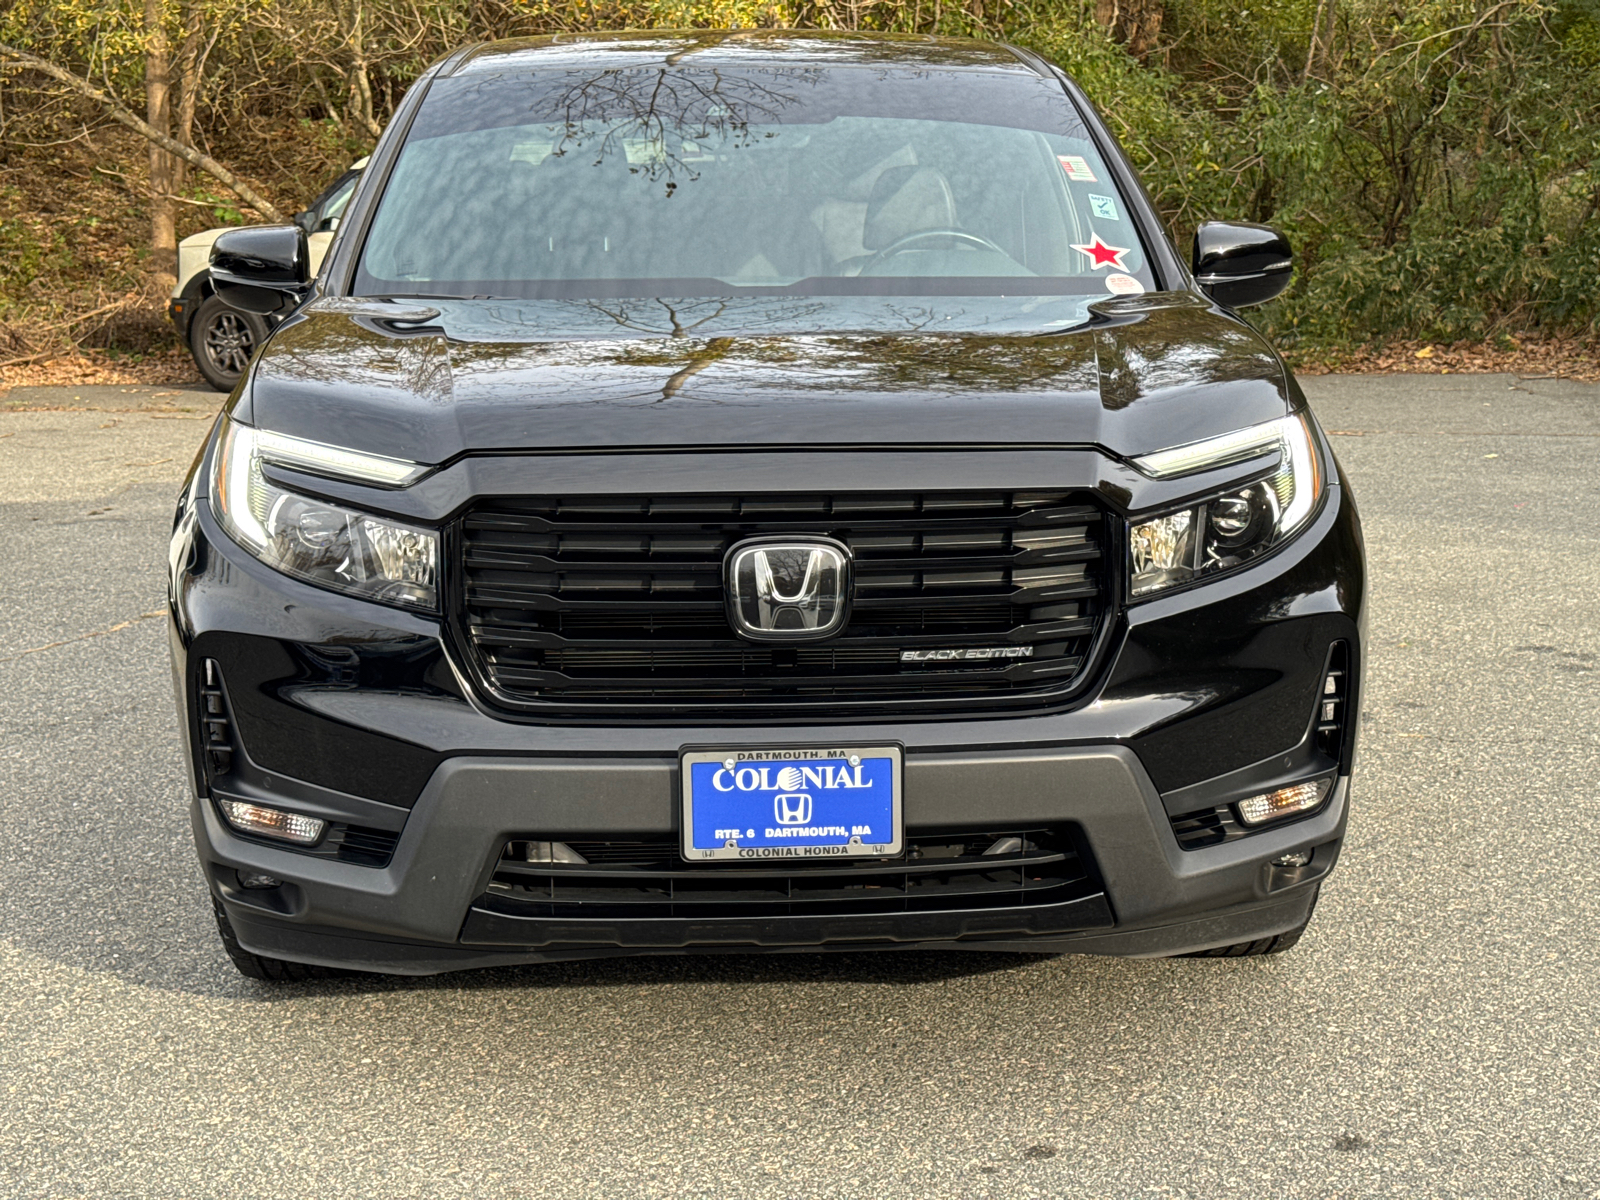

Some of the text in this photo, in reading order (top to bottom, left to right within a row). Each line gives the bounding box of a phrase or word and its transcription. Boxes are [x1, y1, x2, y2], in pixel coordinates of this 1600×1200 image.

[901, 646, 1033, 661] BLACK EDITION
[827, 750, 847, 759] MA
[712, 766, 873, 792] COLONIAL
[715, 825, 872, 839] RTE. 6 DARTMOUTH, MA
[738, 846, 849, 859] COLONIAL HONDA
